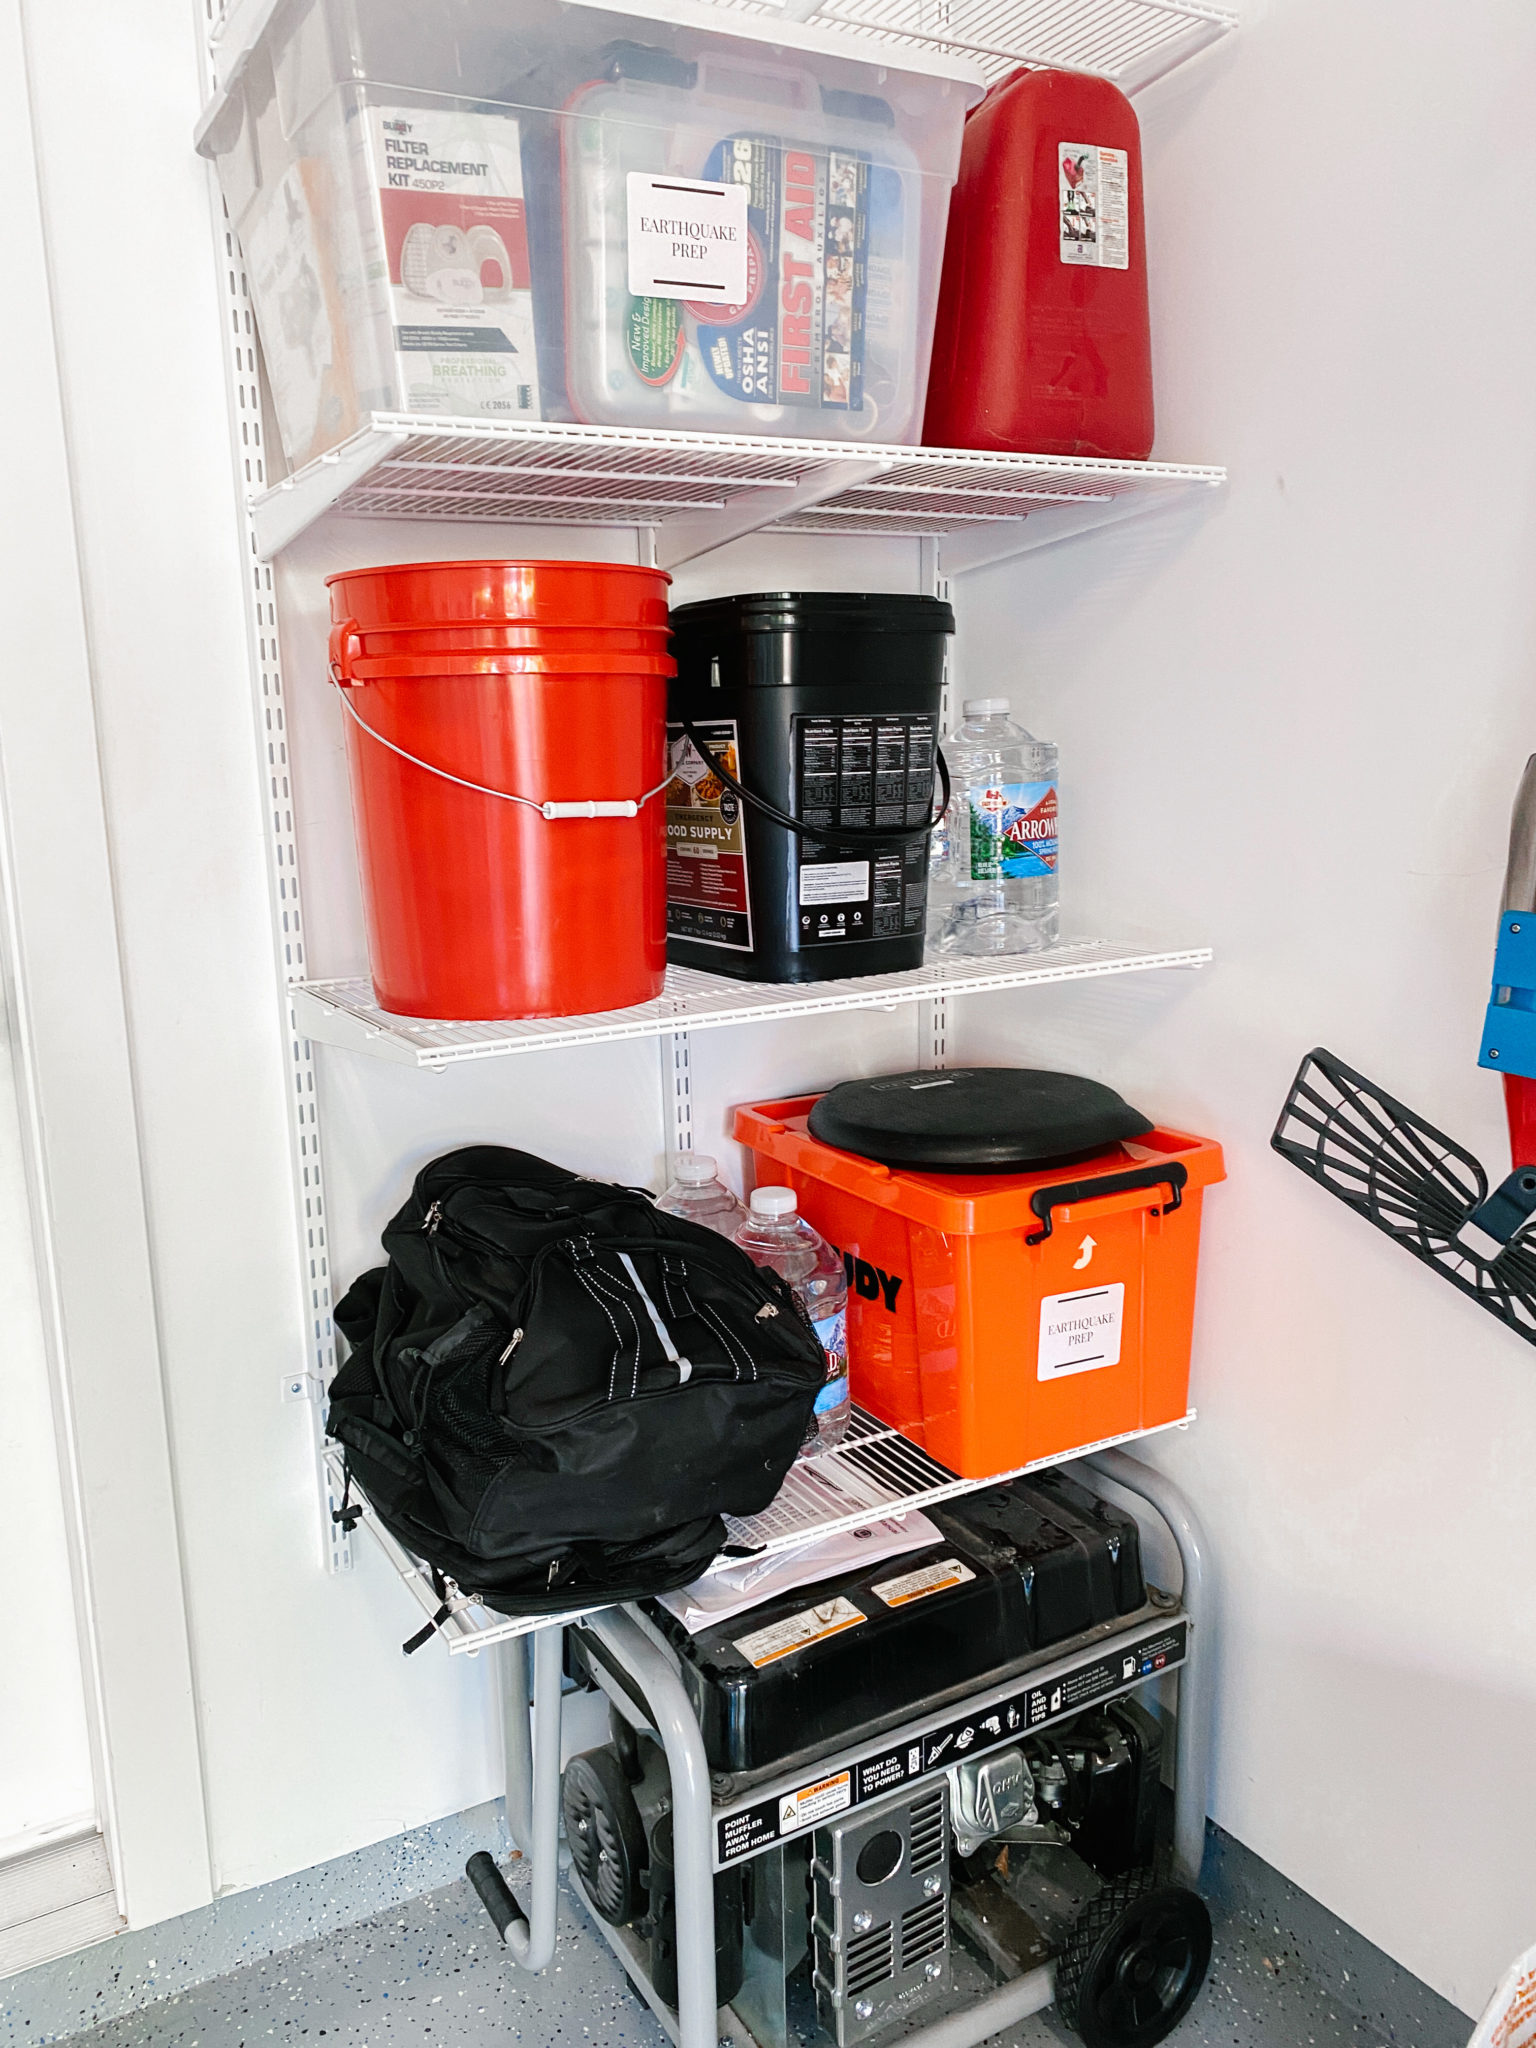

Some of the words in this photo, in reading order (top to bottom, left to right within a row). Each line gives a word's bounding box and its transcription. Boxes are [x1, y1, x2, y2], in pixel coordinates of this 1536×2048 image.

[384, 138, 429, 156] FILTER
[386, 156, 488, 176] REPLACEMENT
[388, 173, 410, 186] KIT
[786, 151, 816, 242] AID
[640, 217, 737, 242] EARTHQUAKE
[816, 176, 825, 264] AUXILIOS
[672, 242, 708, 260] PREP
[632, 312, 641, 322] &
[642, 296, 652, 324] Desig
[781, 253, 814, 394] FIRST
[814, 284, 822, 375] PRIMEROS
[632, 324, 641, 351] New
[641, 327, 650, 372] Improved
[717, 336, 734, 380] UPDATED!
[710, 346, 724, 374] NEWLY
[742, 328, 754, 394] OSHA
[756, 331, 768, 394] ANSI
[432, 365, 506, 377] BREATHING
[674, 814, 713, 822] EMERGENCY
[668, 825, 687, 837] OOD
[690, 826, 732, 840] SUPPLY
[1048, 1312, 1116, 1336] EARTHQUAKE
[1068, 1331, 1094, 1346] PREP
[1032, 1690, 1042, 1700] OIL
[1032, 1696, 1046, 1708] AND
[1031, 1712, 1046, 1723] TIPS
[1032, 1704, 1047, 1716] FUEL
[862, 1760, 884, 1776] WHAT
[886, 1756, 898, 1768] DO
[863, 1772, 879, 1784] YOU
[880, 1764, 901, 1780] NEED
[814, 1778, 840, 1793] WARNING
[863, 1784, 874, 1793] TO
[874, 1770, 904, 1790] POWER?
[724, 1814, 750, 1831] POINT
[724, 1819, 763, 1839] MUFFLER
[725, 1833, 750, 1848] AWAY
[725, 1841, 750, 1858] FROM
[751, 1831, 776, 1848] HOME
